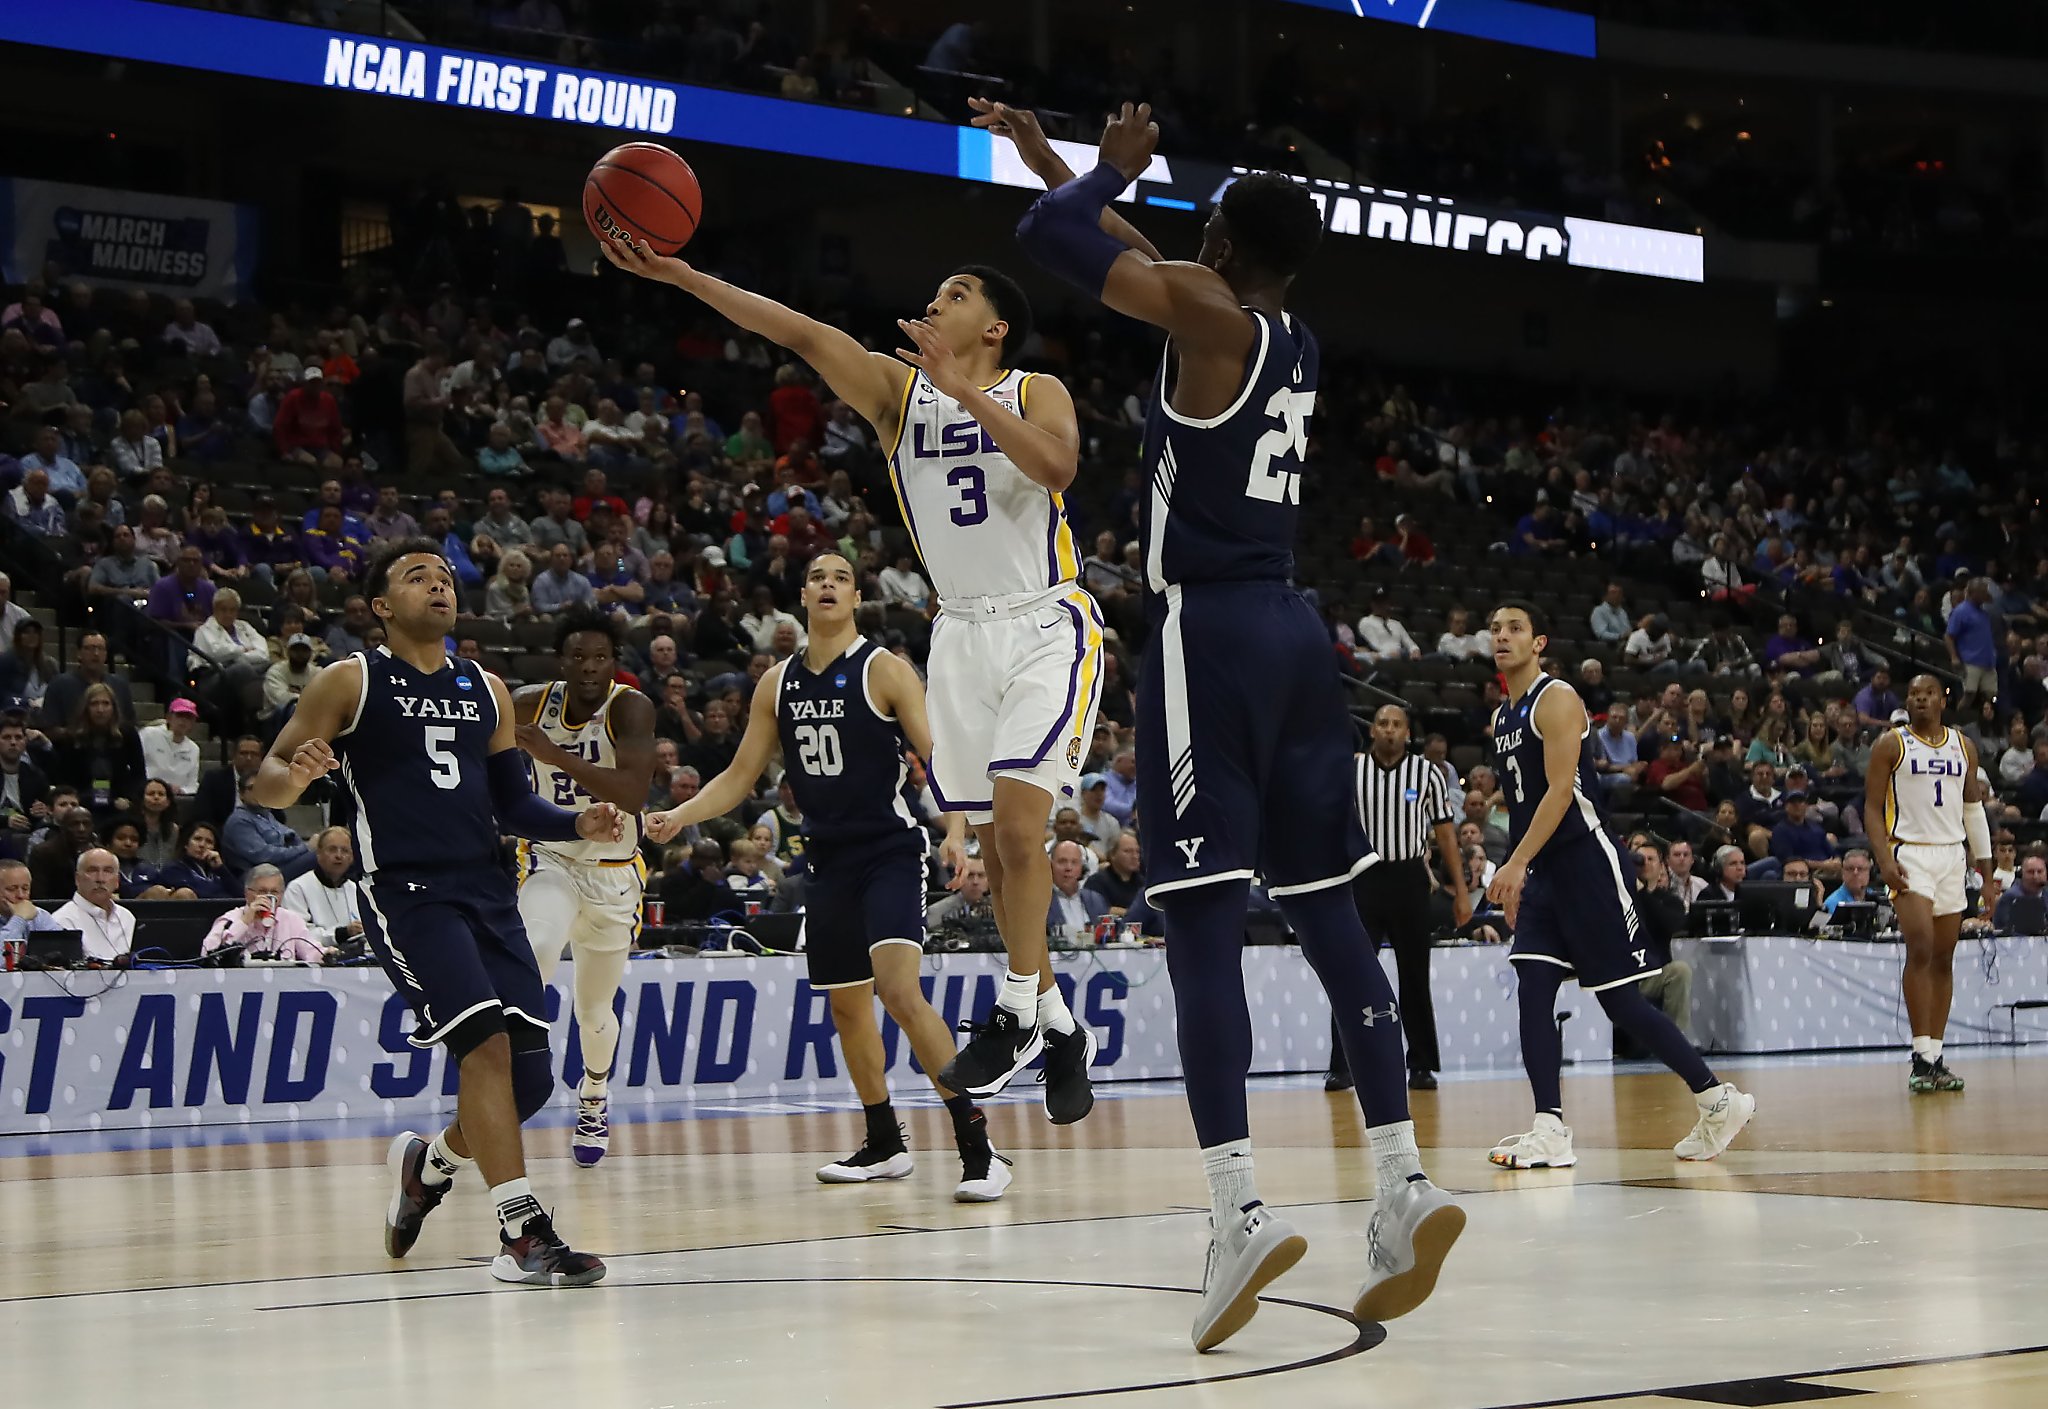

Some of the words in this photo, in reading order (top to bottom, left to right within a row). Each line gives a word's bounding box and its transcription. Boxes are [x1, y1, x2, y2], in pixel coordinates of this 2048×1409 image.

[324, 37, 427, 99] NCAA
[436, 54, 548, 116] FIRST
[551, 72, 678, 135] ROUND
[80, 213, 167, 247] MARCH
[91, 242, 205, 277] MADNESS
[946, 465, 989, 528] 3
[393, 696, 481, 722] YALE
[788, 699, 845, 721] YALE
[424, 725, 461, 790] 5
[794, 724, 844, 777] 20
[1495, 727, 1523, 754] YALE
[1505, 754, 1525, 804] 3
[1910, 757, 1963, 778] LSU
[1933, 778, 1944, 807] 1
[1174, 836, 1205, 870] Y
[1630, 948, 1647, 968] Y
[106, 991, 338, 1111] AND
[370, 978, 757, 1100] SND
